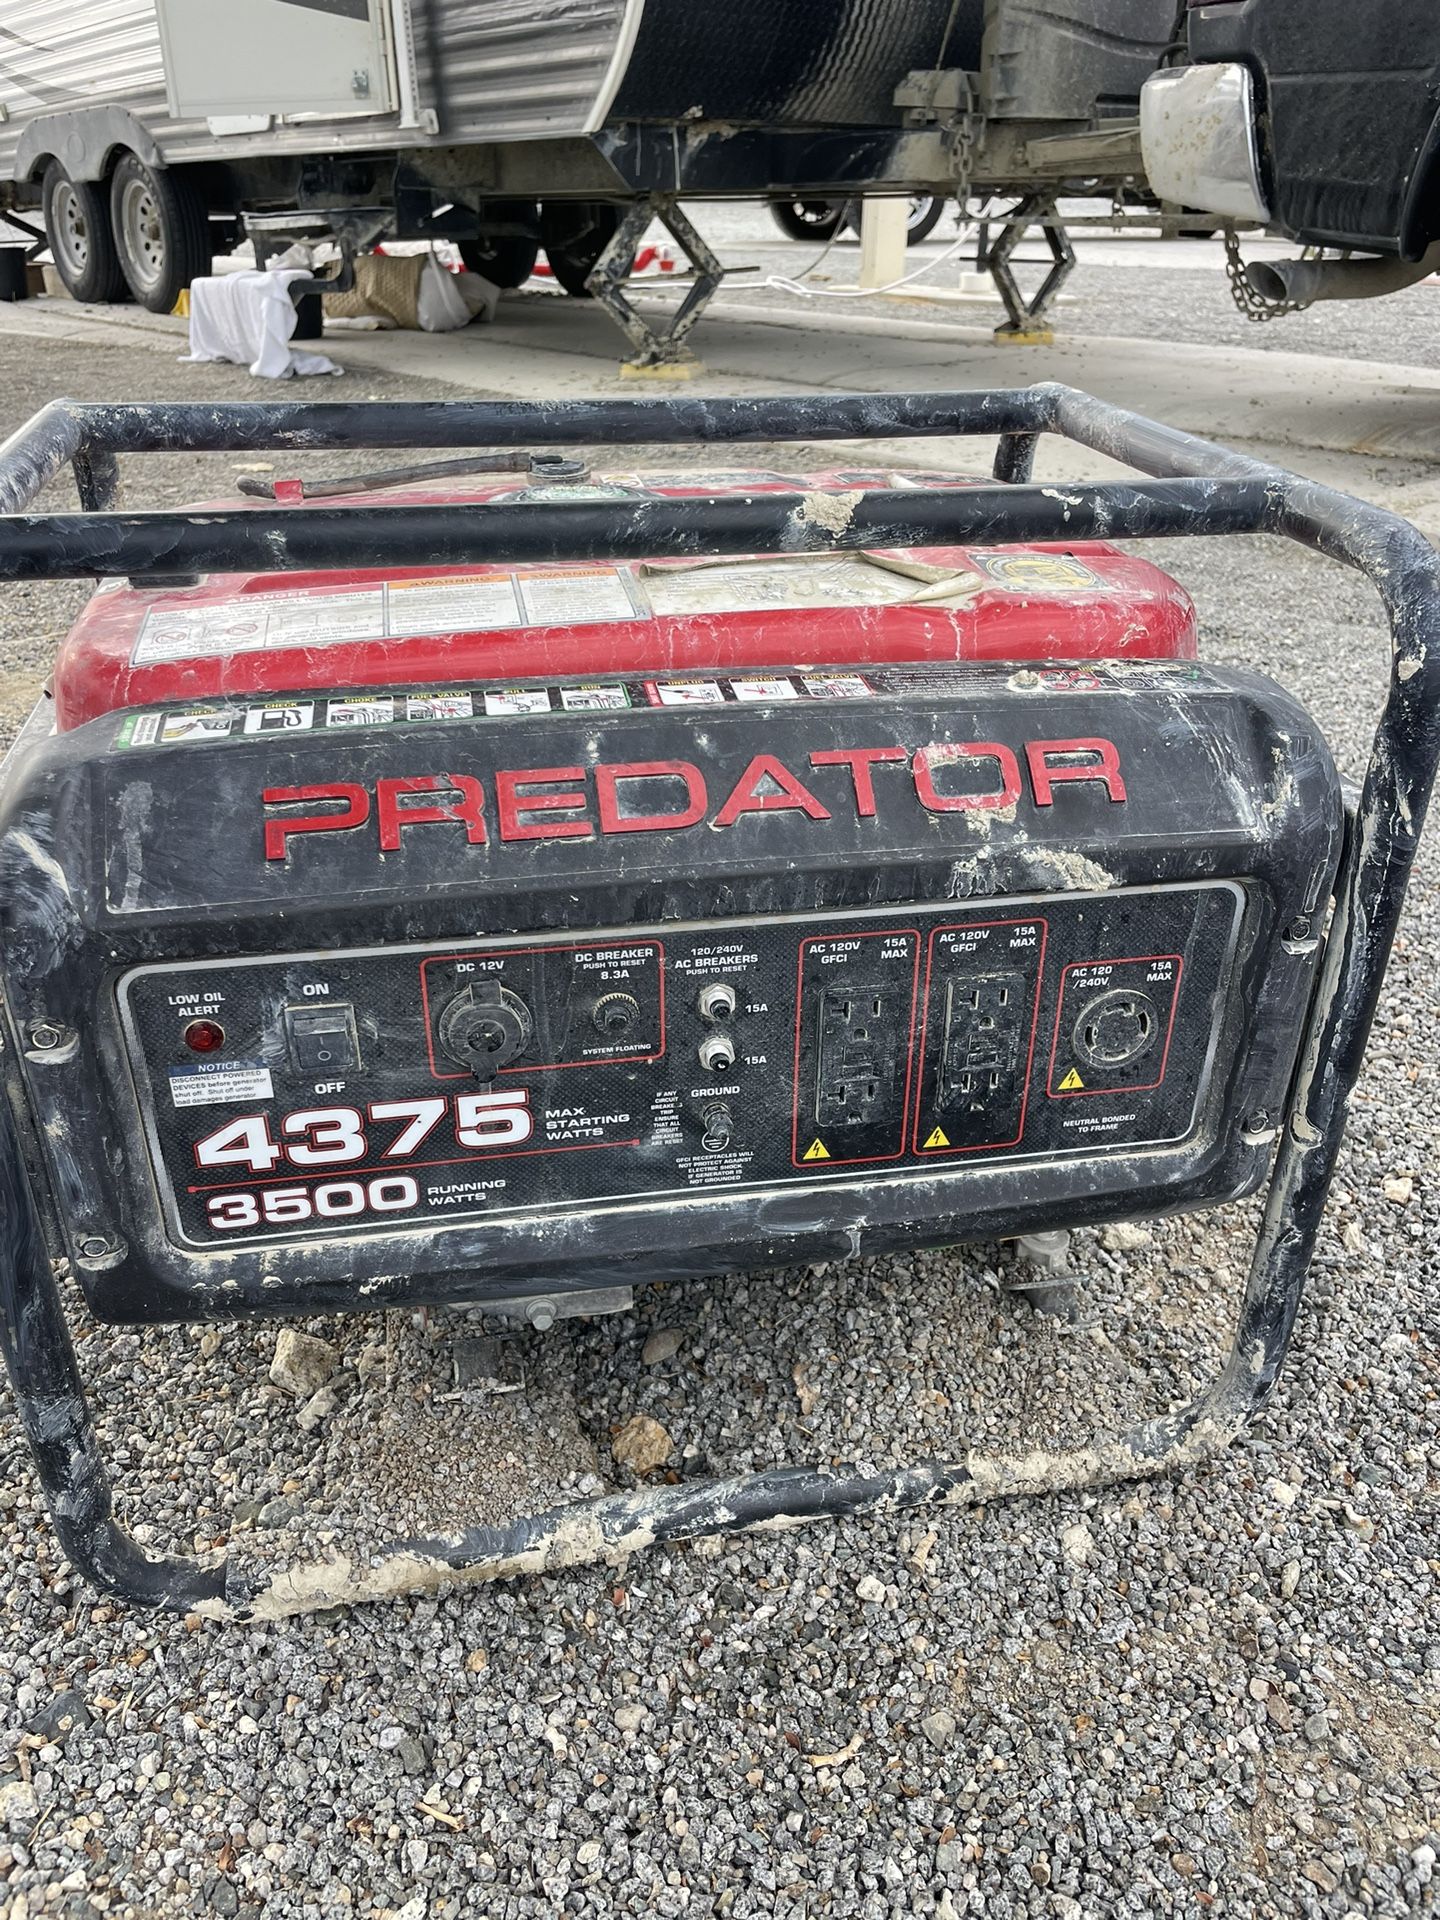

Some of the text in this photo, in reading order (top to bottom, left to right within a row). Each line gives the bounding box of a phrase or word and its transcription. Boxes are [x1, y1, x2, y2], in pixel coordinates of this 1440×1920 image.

[420, 577, 491, 586] WARNING
[238, 591, 309, 602] DANGER
[263, 738, 1126, 860] PREDATOR
[939, 930, 990, 943] AC 120V
[1013, 926, 1036, 936] 15A
[809, 941, 860, 954] AC 120V
[884, 938, 907, 947] 15A
[950, 943, 977, 953] GFCI
[1010, 937, 1036, 948] MAX
[575, 948, 653, 963] DC BREAKER
[691, 945, 743, 956] 120/240V
[881, 948, 908, 959] MAX
[583, 962, 606, 970] PUSH
[620, 959, 646, 967] RESET
[675, 954, 758, 969] AC BREAKERS
[821, 954, 847, 964] GFCI
[457, 960, 504, 973] DC 12V
[1072, 966, 1112, 977] AC 120
[1150, 961, 1172, 971] 15A
[601, 970, 630, 980] 8.3A
[1146, 972, 1172, 982] MAX
[1073, 976, 1109, 989] /240V
[303, 983, 329, 996] ON
[168, 992, 225, 1005] LOW OIL
[178, 1005, 220, 1017] ALERT
[745, 1003, 768, 1013] 15A
[583, 1044, 652, 1055] SYSTEM FLOATING
[744, 1055, 767, 1065] 15A
[198, 1061, 240, 1072] NOTICE
[172, 1070, 262, 1084] DISCONNECT POWERED
[173, 1078, 267, 1091] DEVICES before generator
[314, 1081, 345, 1095] OFF
[691, 1086, 740, 1097] GROUND
[192, 1096, 222, 1104] damages
[546, 1107, 583, 1119] MAX
[546, 1113, 631, 1130] STARTING
[1063, 1114, 1136, 1127] NEUTRAL BONDED
[195, 1087, 534, 1172] 4375
[1091, 1123, 1118, 1132] FRAME
[546, 1127, 604, 1141] WATTS
[651, 1132, 683, 1140] BREAKERS
[692, 1152, 737, 1162] RECEPTACLES
[695, 1170, 735, 1179] GENERATOR
[704, 1175, 741, 1183] GROUNDED
[427, 1178, 506, 1195] RUNNING
[206, 1174, 419, 1230] 3500
[428, 1192, 487, 1206] WATTS
